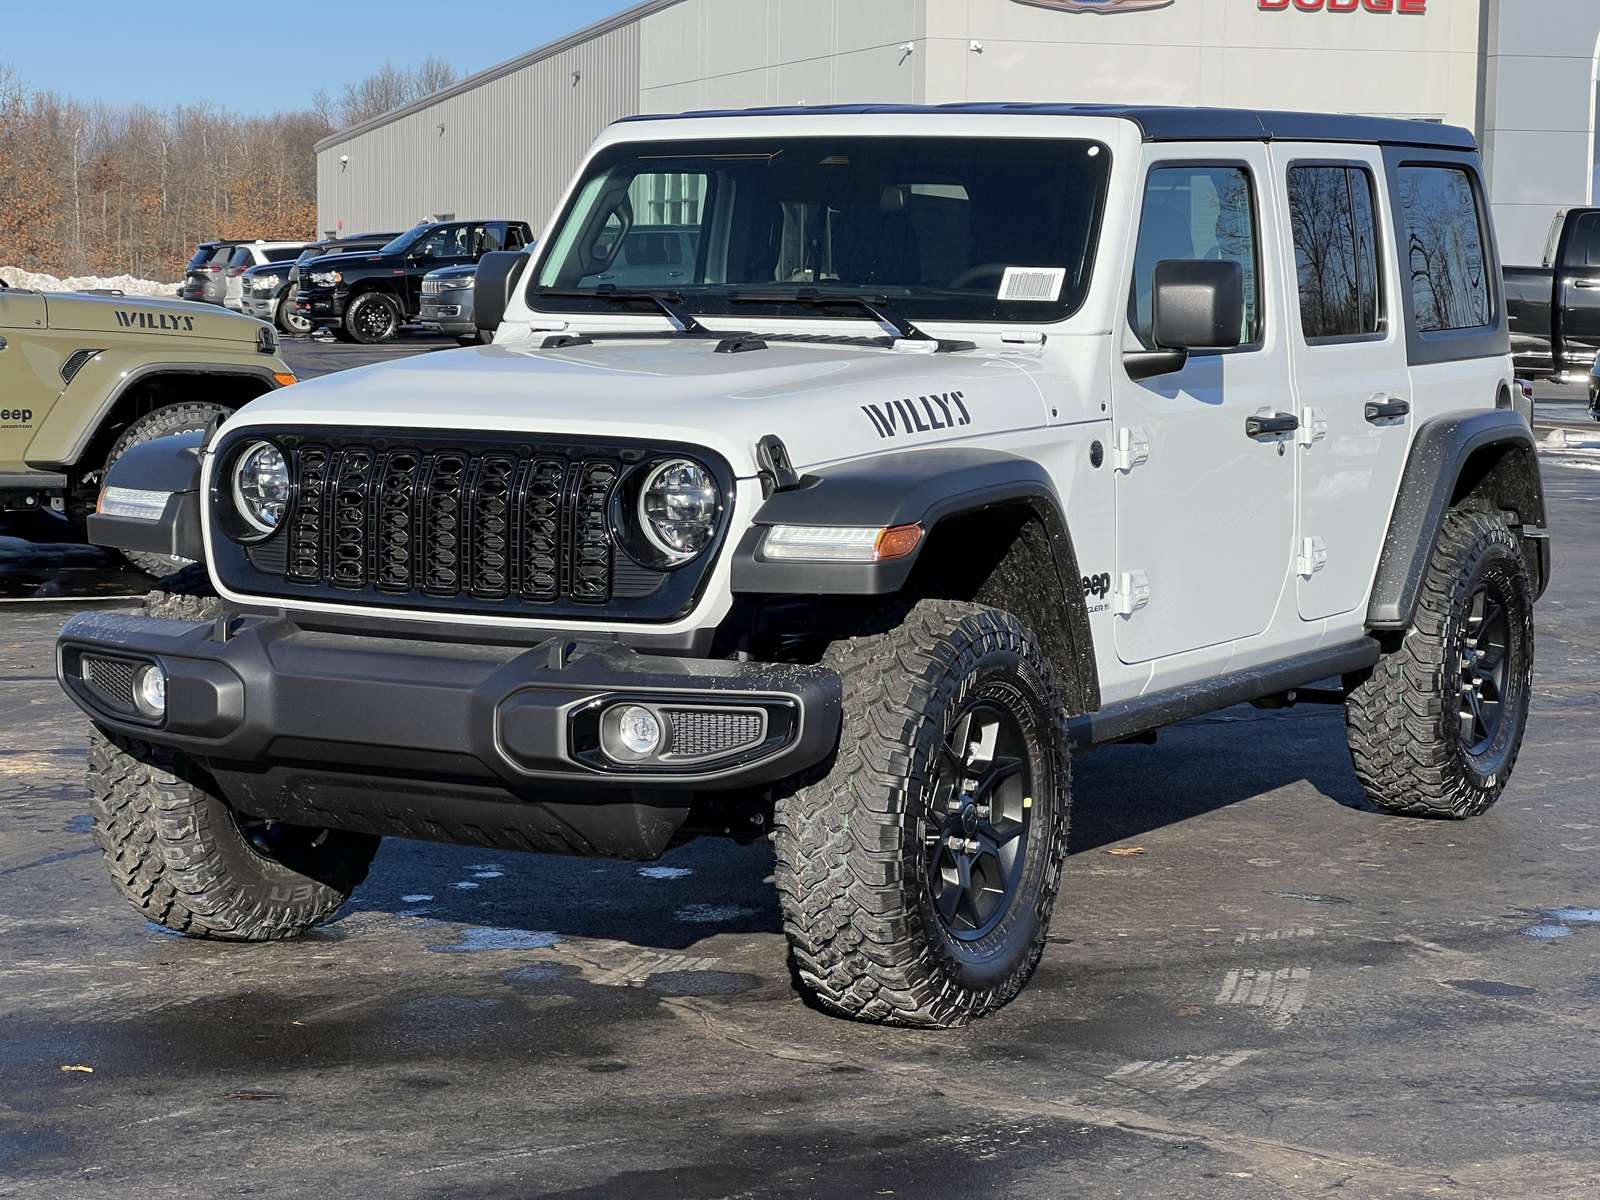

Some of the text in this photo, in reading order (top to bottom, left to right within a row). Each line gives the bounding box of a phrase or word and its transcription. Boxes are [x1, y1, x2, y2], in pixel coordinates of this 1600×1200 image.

[114, 310, 195, 331] WILLYS
[0, 409, 33, 422] eep
[860, 390, 971, 438] WILLYS
[1081, 572, 1111, 600] eep
